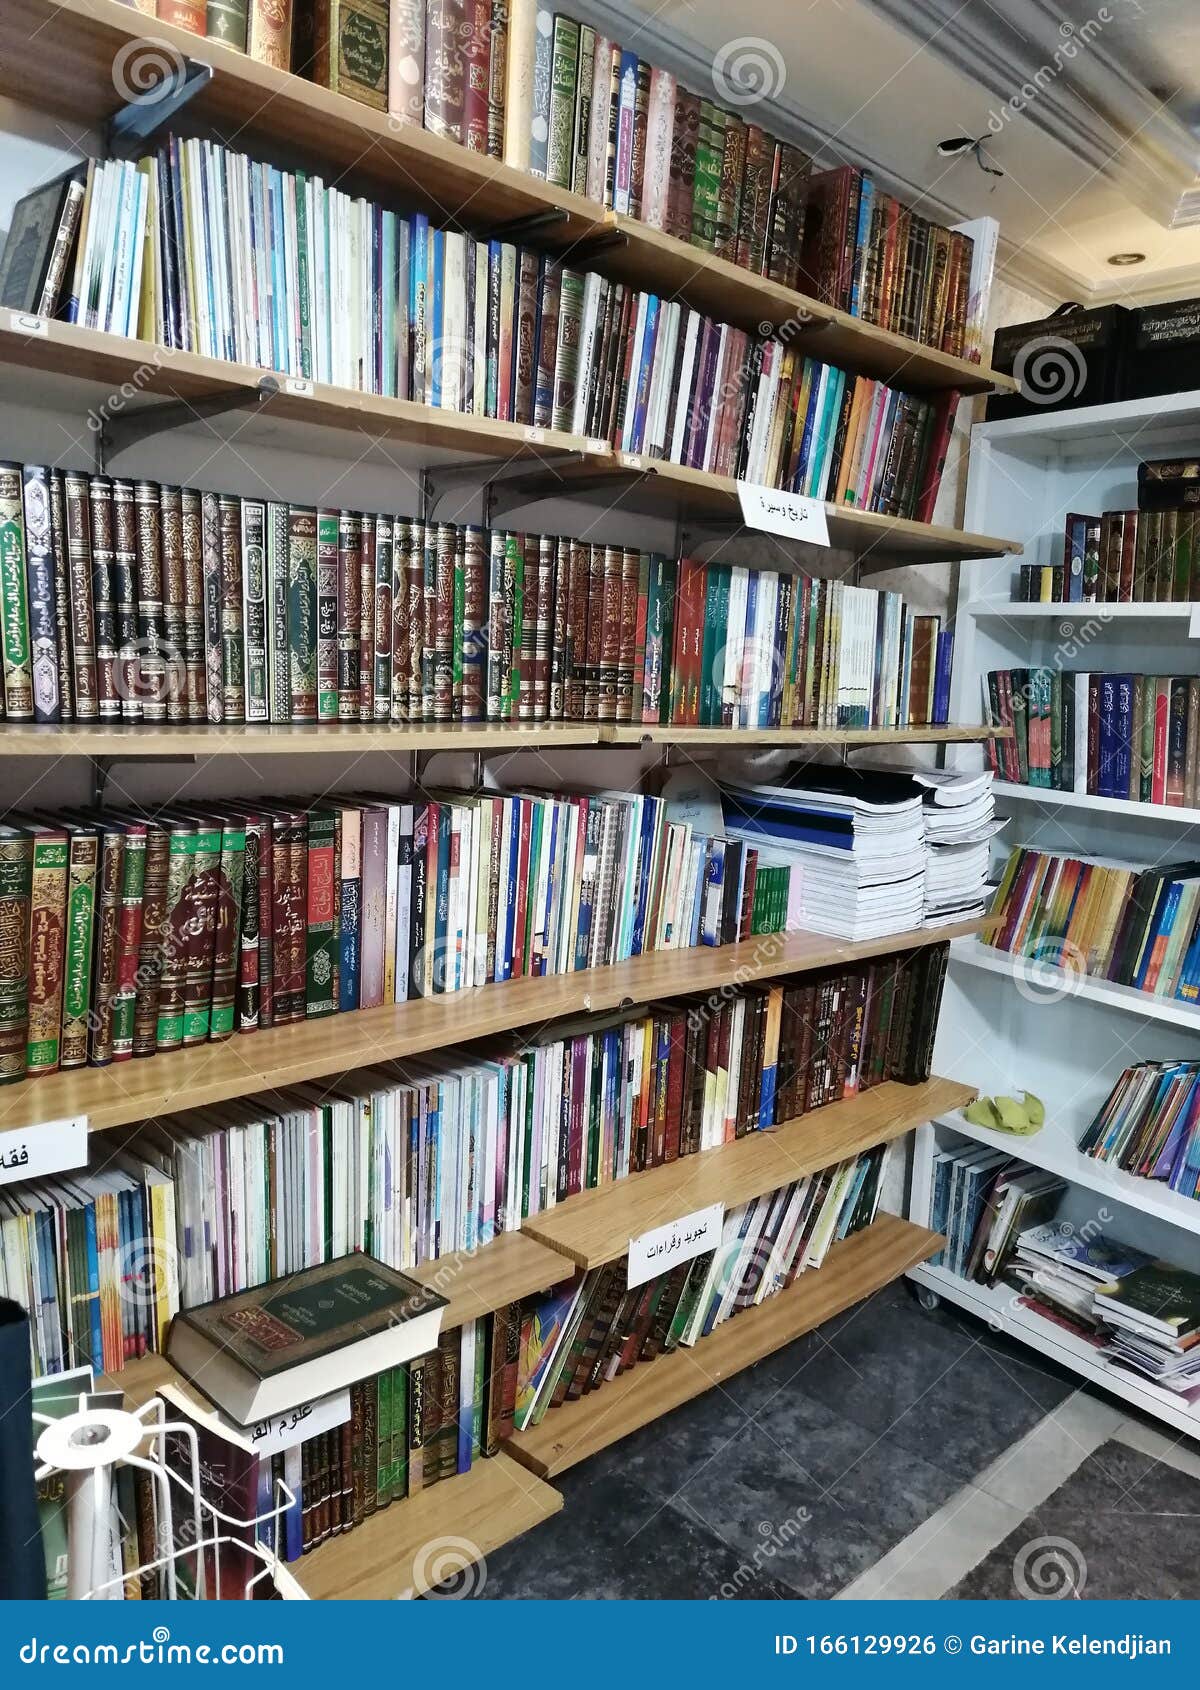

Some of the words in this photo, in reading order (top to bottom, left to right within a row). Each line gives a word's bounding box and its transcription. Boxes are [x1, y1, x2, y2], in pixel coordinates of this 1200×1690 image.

[789, 504, 808, 521] تاريخ
[275, 580, 286, 615] السراج
[275, 616, 286, 649] الوهاج
[646, 1233, 681, 1259] وقراءات
[684, 1222, 707, 1244] تجويد
[251, 1418, 271, 1444] القر
[279, 1405, 312, 1437] علوم
